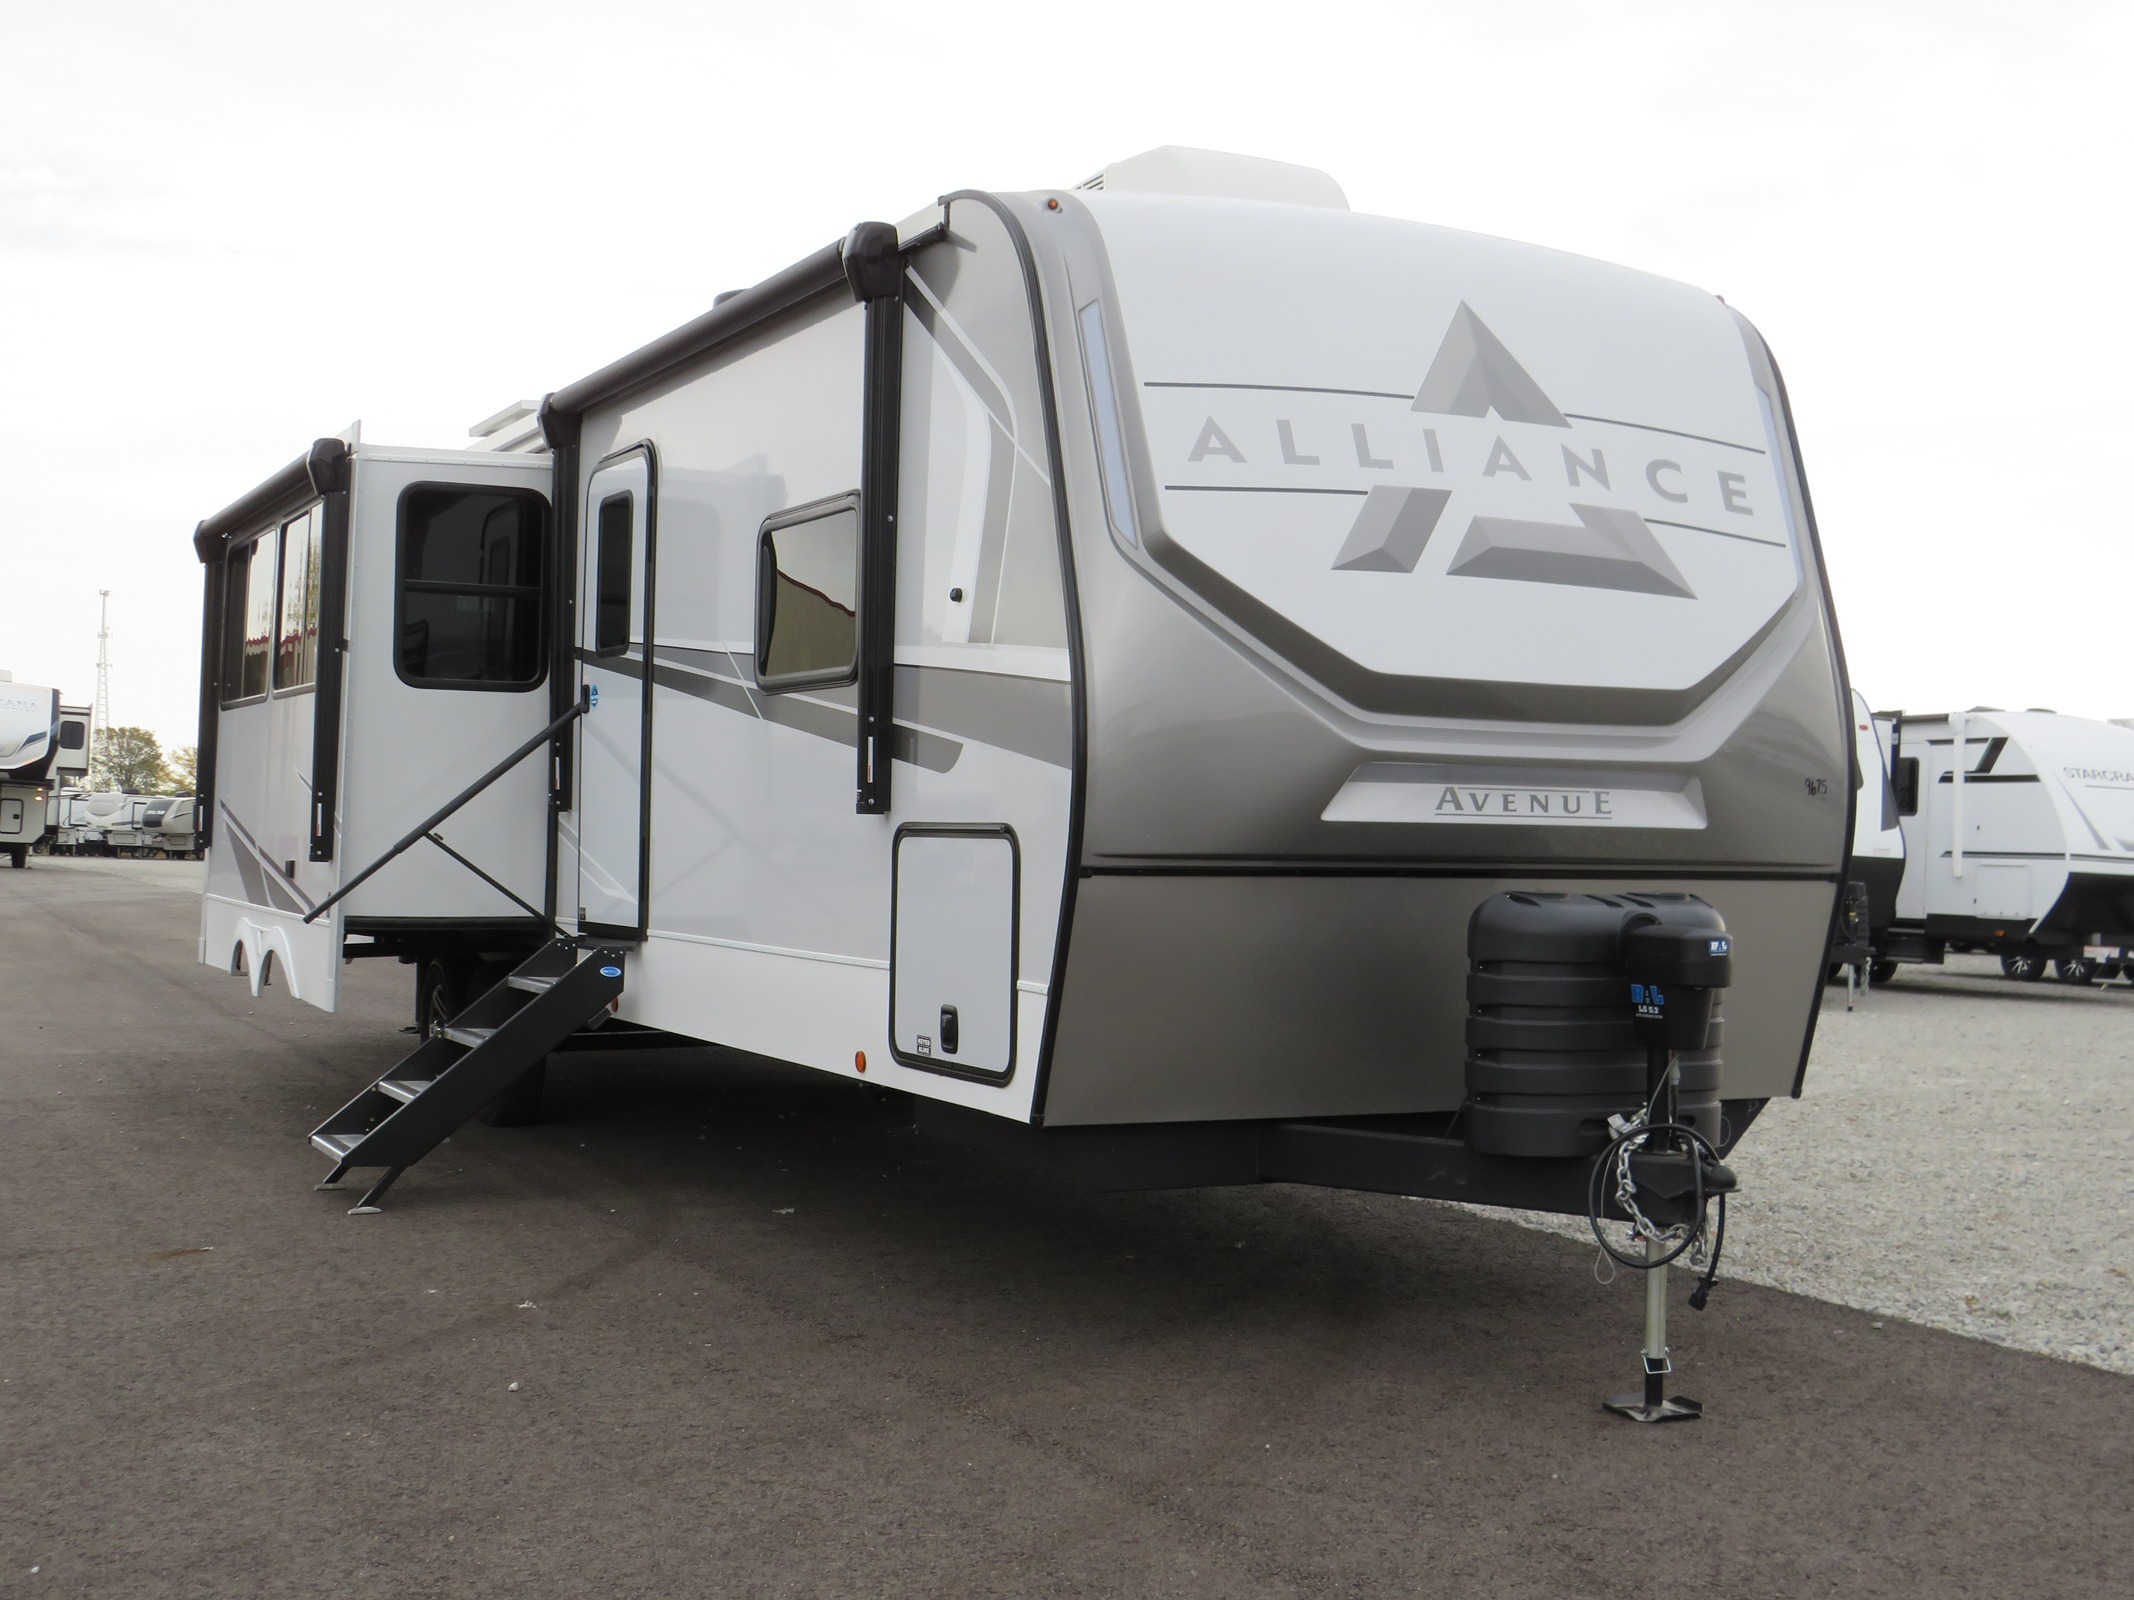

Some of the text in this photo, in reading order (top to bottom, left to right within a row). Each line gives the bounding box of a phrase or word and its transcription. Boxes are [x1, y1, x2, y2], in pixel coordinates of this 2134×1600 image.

[1186, 415, 1755, 517] ALLIANCE
[1435, 786, 1612, 815] AVENUE
[1803, 776, 1828, 796] 9675
